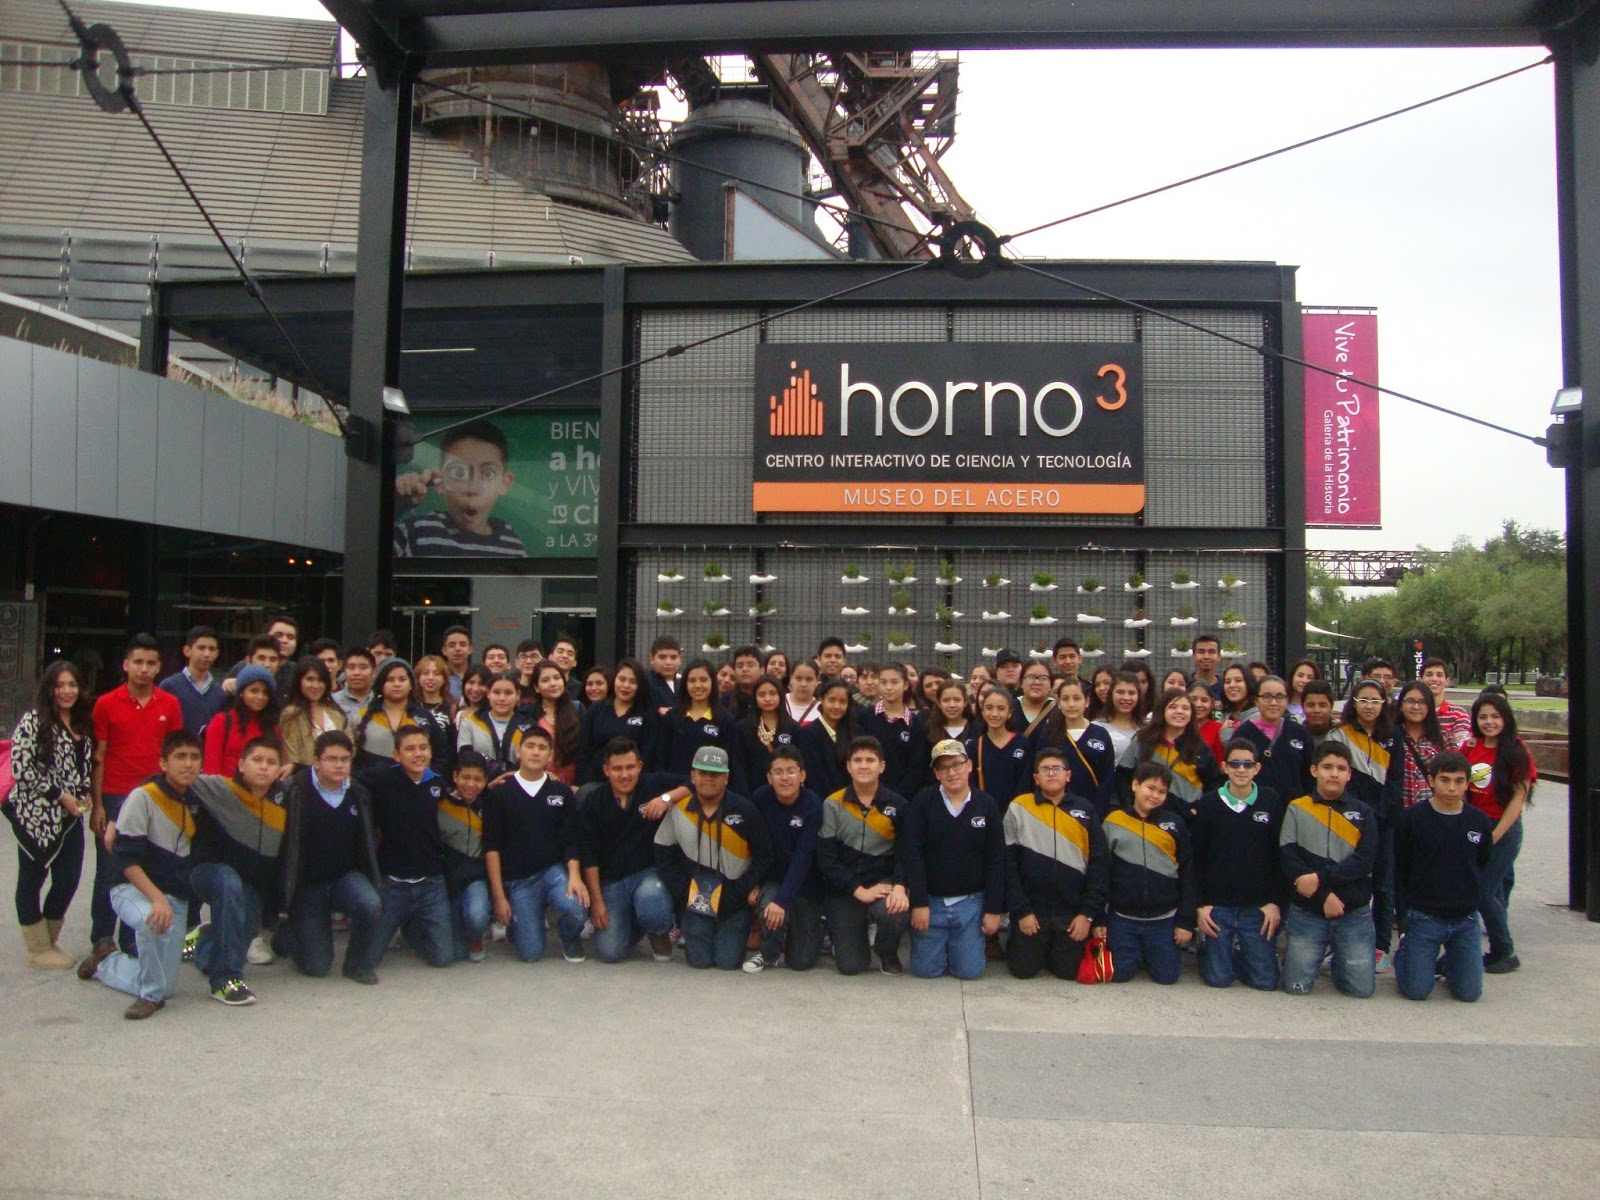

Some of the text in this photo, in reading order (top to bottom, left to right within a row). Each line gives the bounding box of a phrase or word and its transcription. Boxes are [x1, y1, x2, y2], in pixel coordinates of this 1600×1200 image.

[1335, 321, 1355, 362] Vive
[840, 363, 1127, 437] horno 3
[549, 445, 600, 471] a h
[766, 452, 1132, 469] CENTRO INTERACTIVO DE CIENCIA Y TECNOLOGÍA
[1324, 448, 1334, 461] de
[1336, 394, 1360, 514] Patrimonio
[1324, 463, 1334, 472] la
[844, 489, 1061, 507] MUSEO DEL ACERO
[1324, 475, 1334, 514] Historia
[546, 536, 555, 548] a
[560, 533, 578, 548] LA
